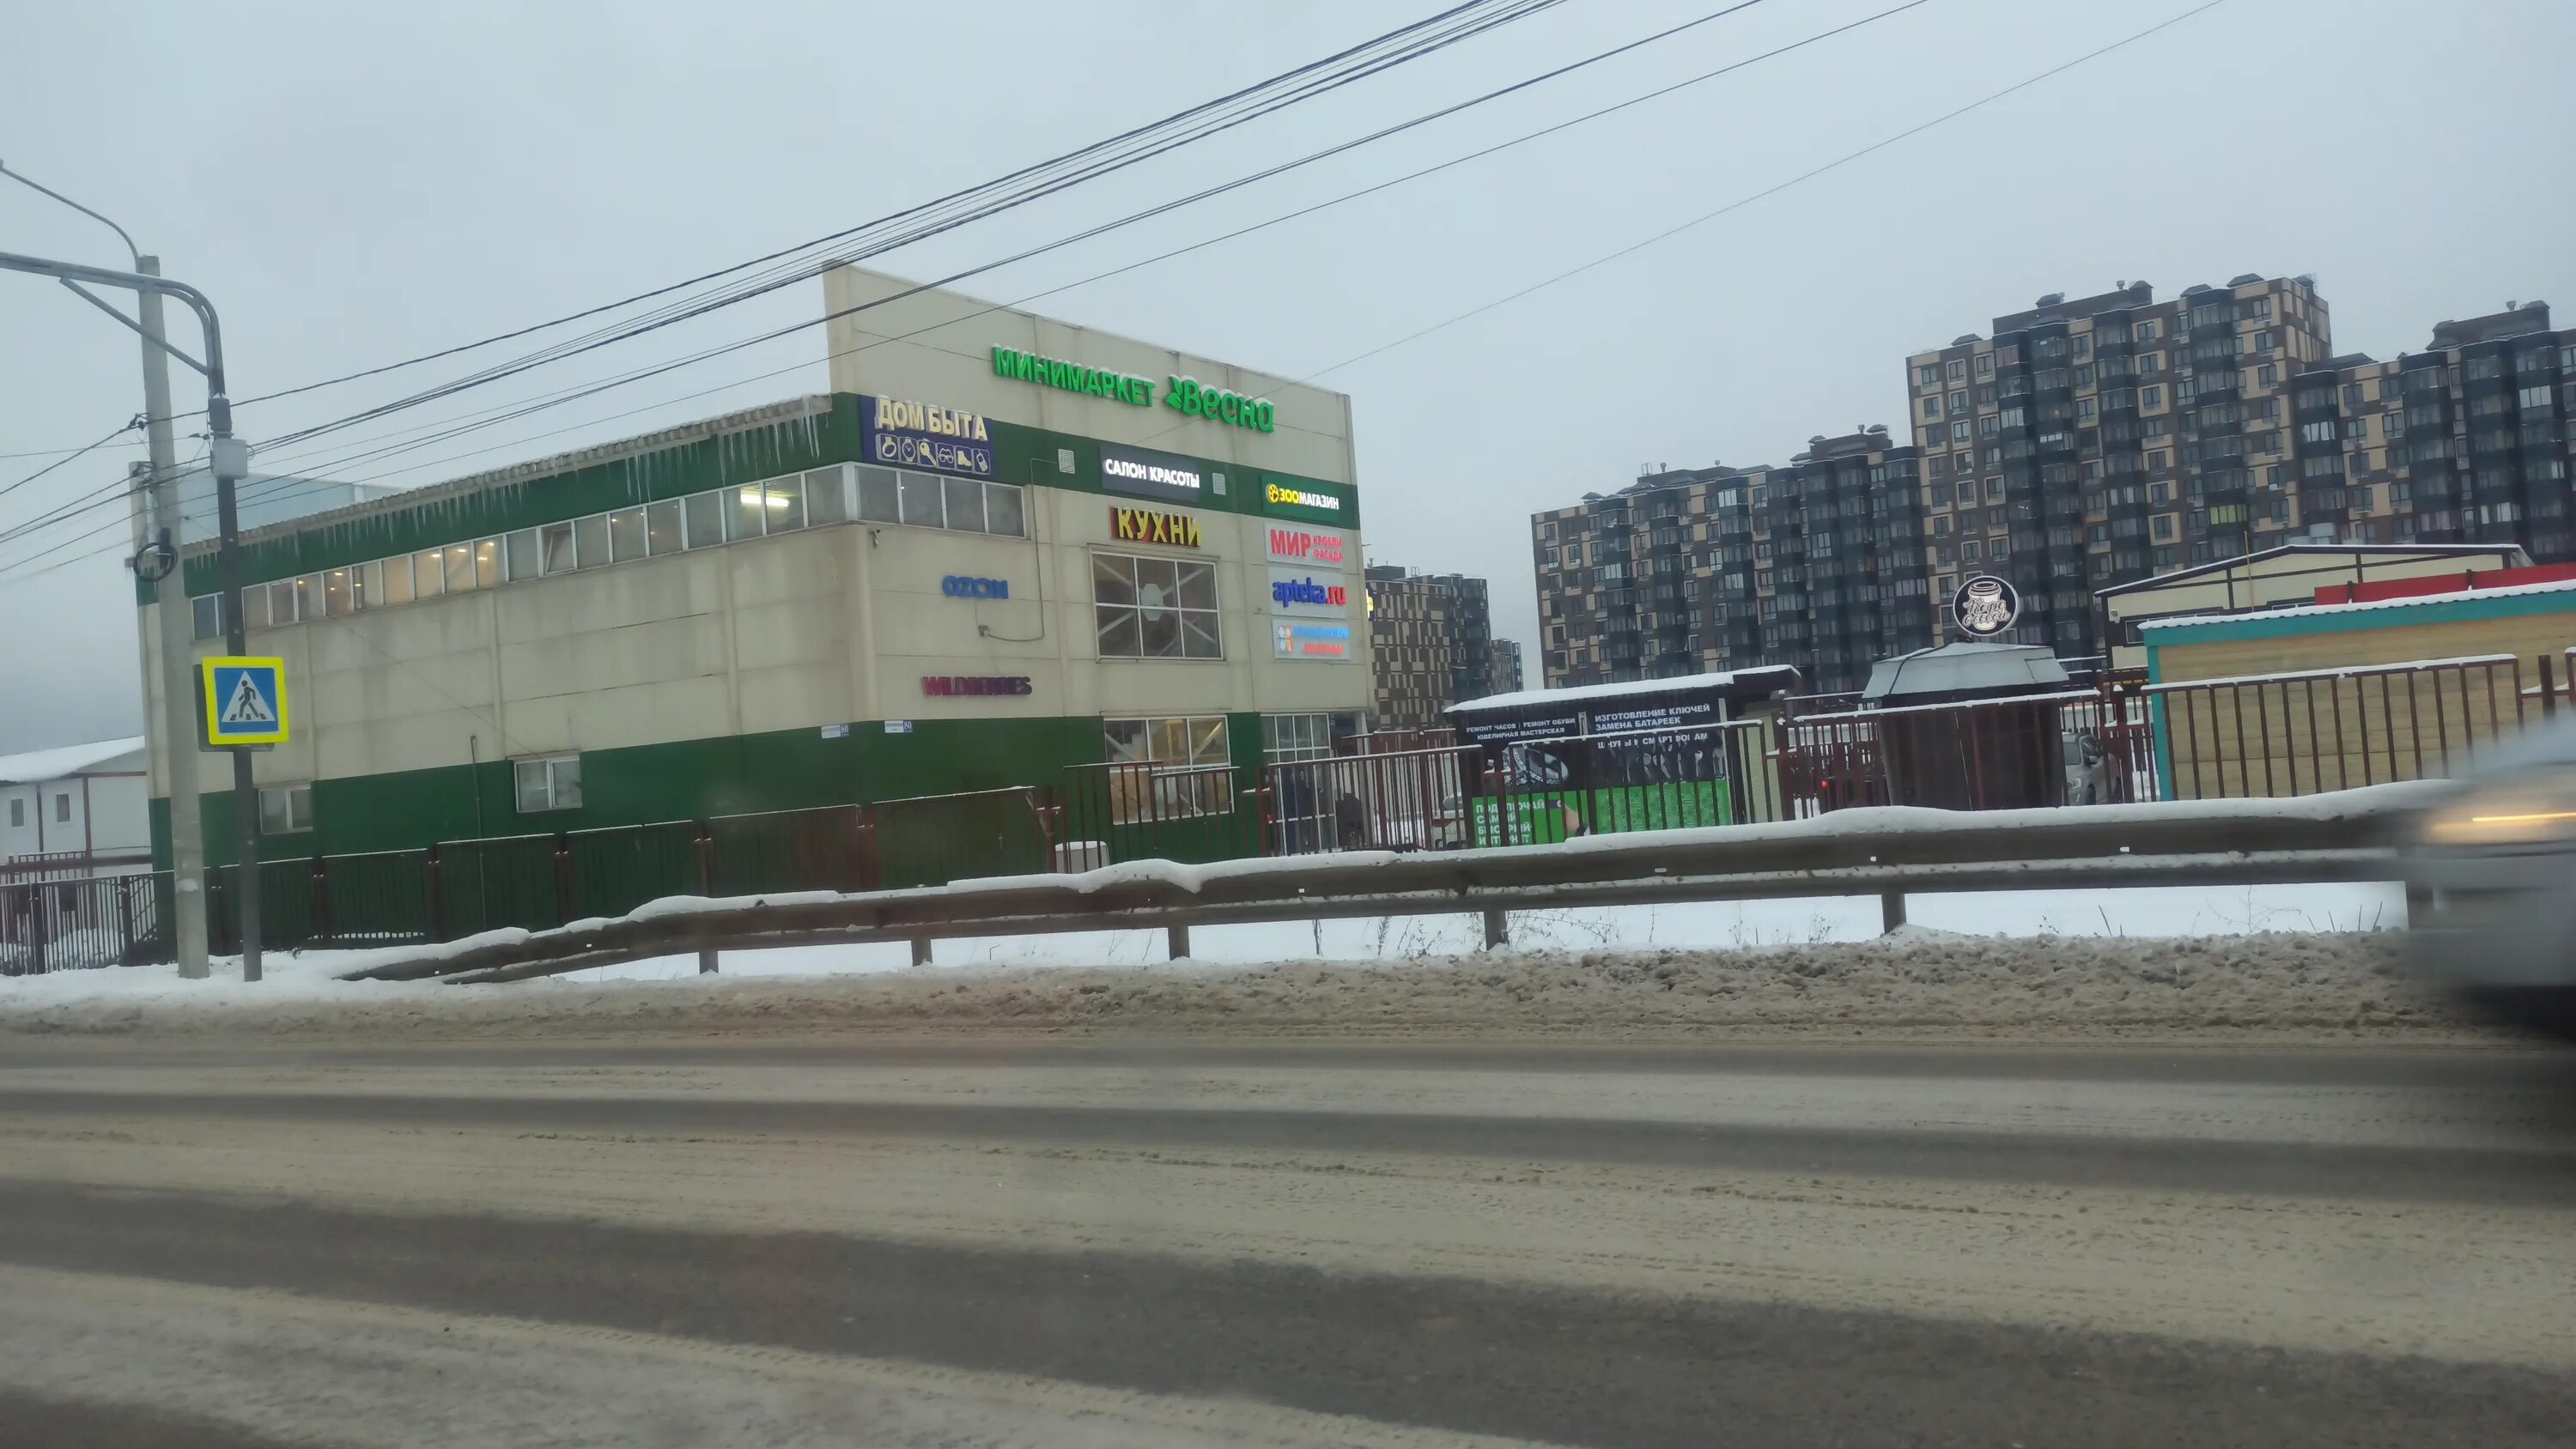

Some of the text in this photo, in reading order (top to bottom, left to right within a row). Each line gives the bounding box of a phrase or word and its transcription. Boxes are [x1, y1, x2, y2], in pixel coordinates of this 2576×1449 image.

[992, 345, 1275, 433] МИНИМАРКЕТ Весна
[875, 397, 988, 441] ДОМ БЫТА
[1103, 458, 1200, 488] САЛОН КРАСОТЫ
[1279, 488, 1340, 510] ЗООМАГАЗИН
[1116, 507, 1202, 547] КУХНИ
[1270, 529, 1311, 557] МИР
[942, 576, 1009, 599] OZON
[1273, 577, 1346, 608] apteka.ru
[1595, 703, 1710, 722] ИЗГОТОВЛЕНИЕ КЛЮЧЕЙ
[841, 724, 849, 734] 80
[903, 721, 912, 730] 80
[1467, 724, 1492, 733] РЕМОНТ
[1523, 719, 1550, 728] РЕМОНТ
[1477, 727, 1565, 740] ЮВЕЛИРНАЯ МАСТЕРСКАЯ
[1595, 717, 1681, 731] ЗАМЕНА БАТАРЕЕК
